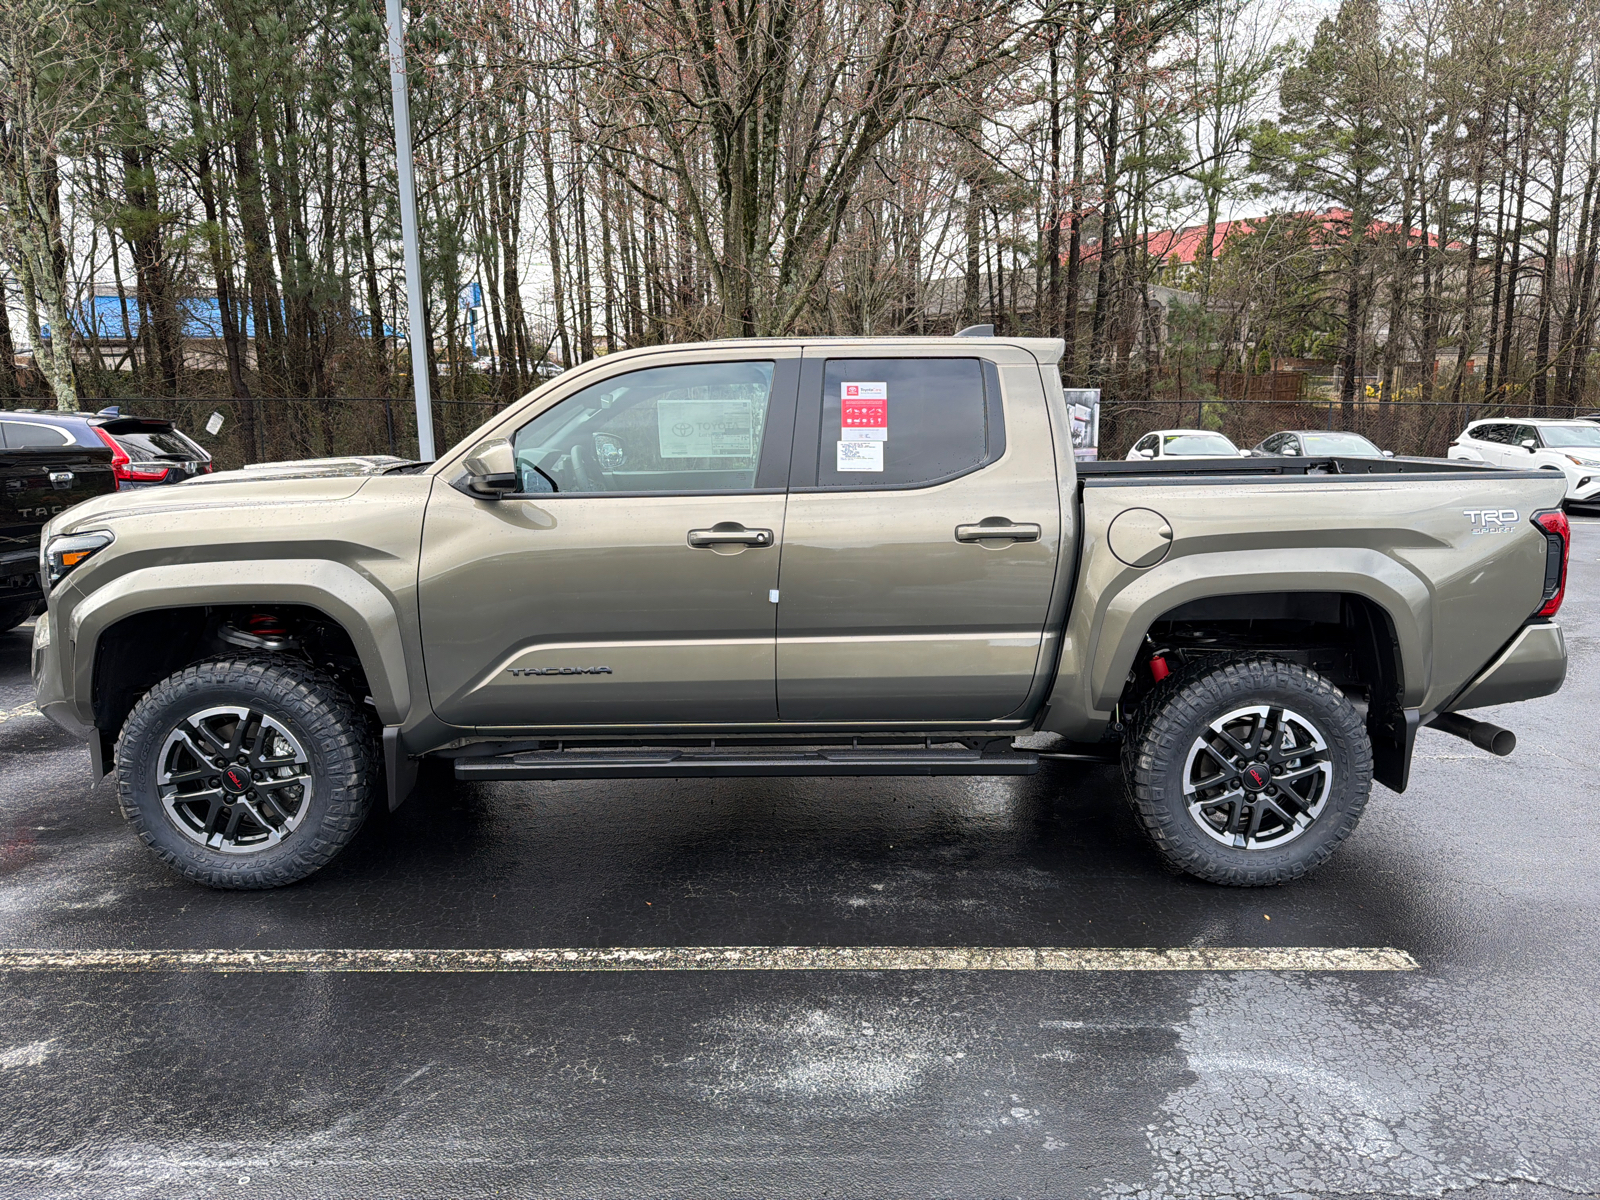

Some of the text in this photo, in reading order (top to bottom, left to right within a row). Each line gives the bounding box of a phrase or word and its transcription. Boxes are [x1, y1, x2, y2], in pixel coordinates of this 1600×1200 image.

[696, 421, 739, 431] TOYOTA
[18, 505, 72, 518] TAC
[1463, 508, 1520, 527] TRD
[1471, 526, 1516, 535] SPORT
[506, 665, 613, 677] TACOMA
